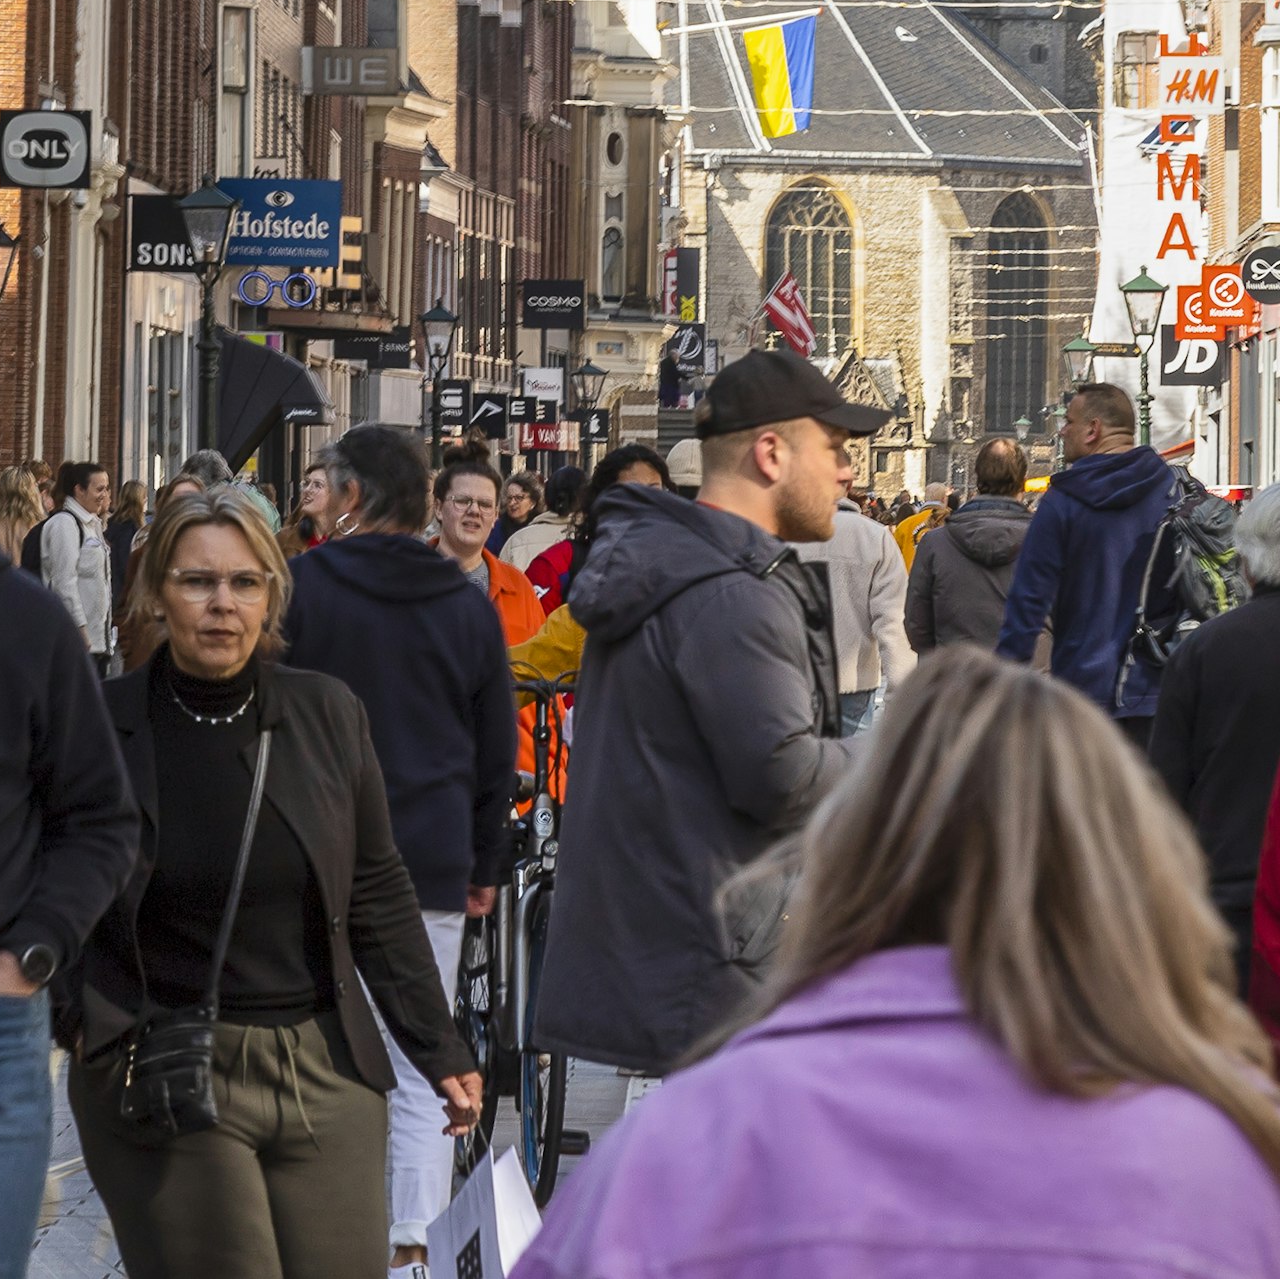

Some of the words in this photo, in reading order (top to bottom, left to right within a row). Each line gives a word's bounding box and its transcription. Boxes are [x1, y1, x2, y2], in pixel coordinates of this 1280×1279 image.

[324, 56, 388, 85] WE
[7, 139, 81, 160] ONLY
[231, 209, 330, 240] Hofstede
[526, 295, 582, 307] COSMO
[1163, 338, 1219, 375] JD
